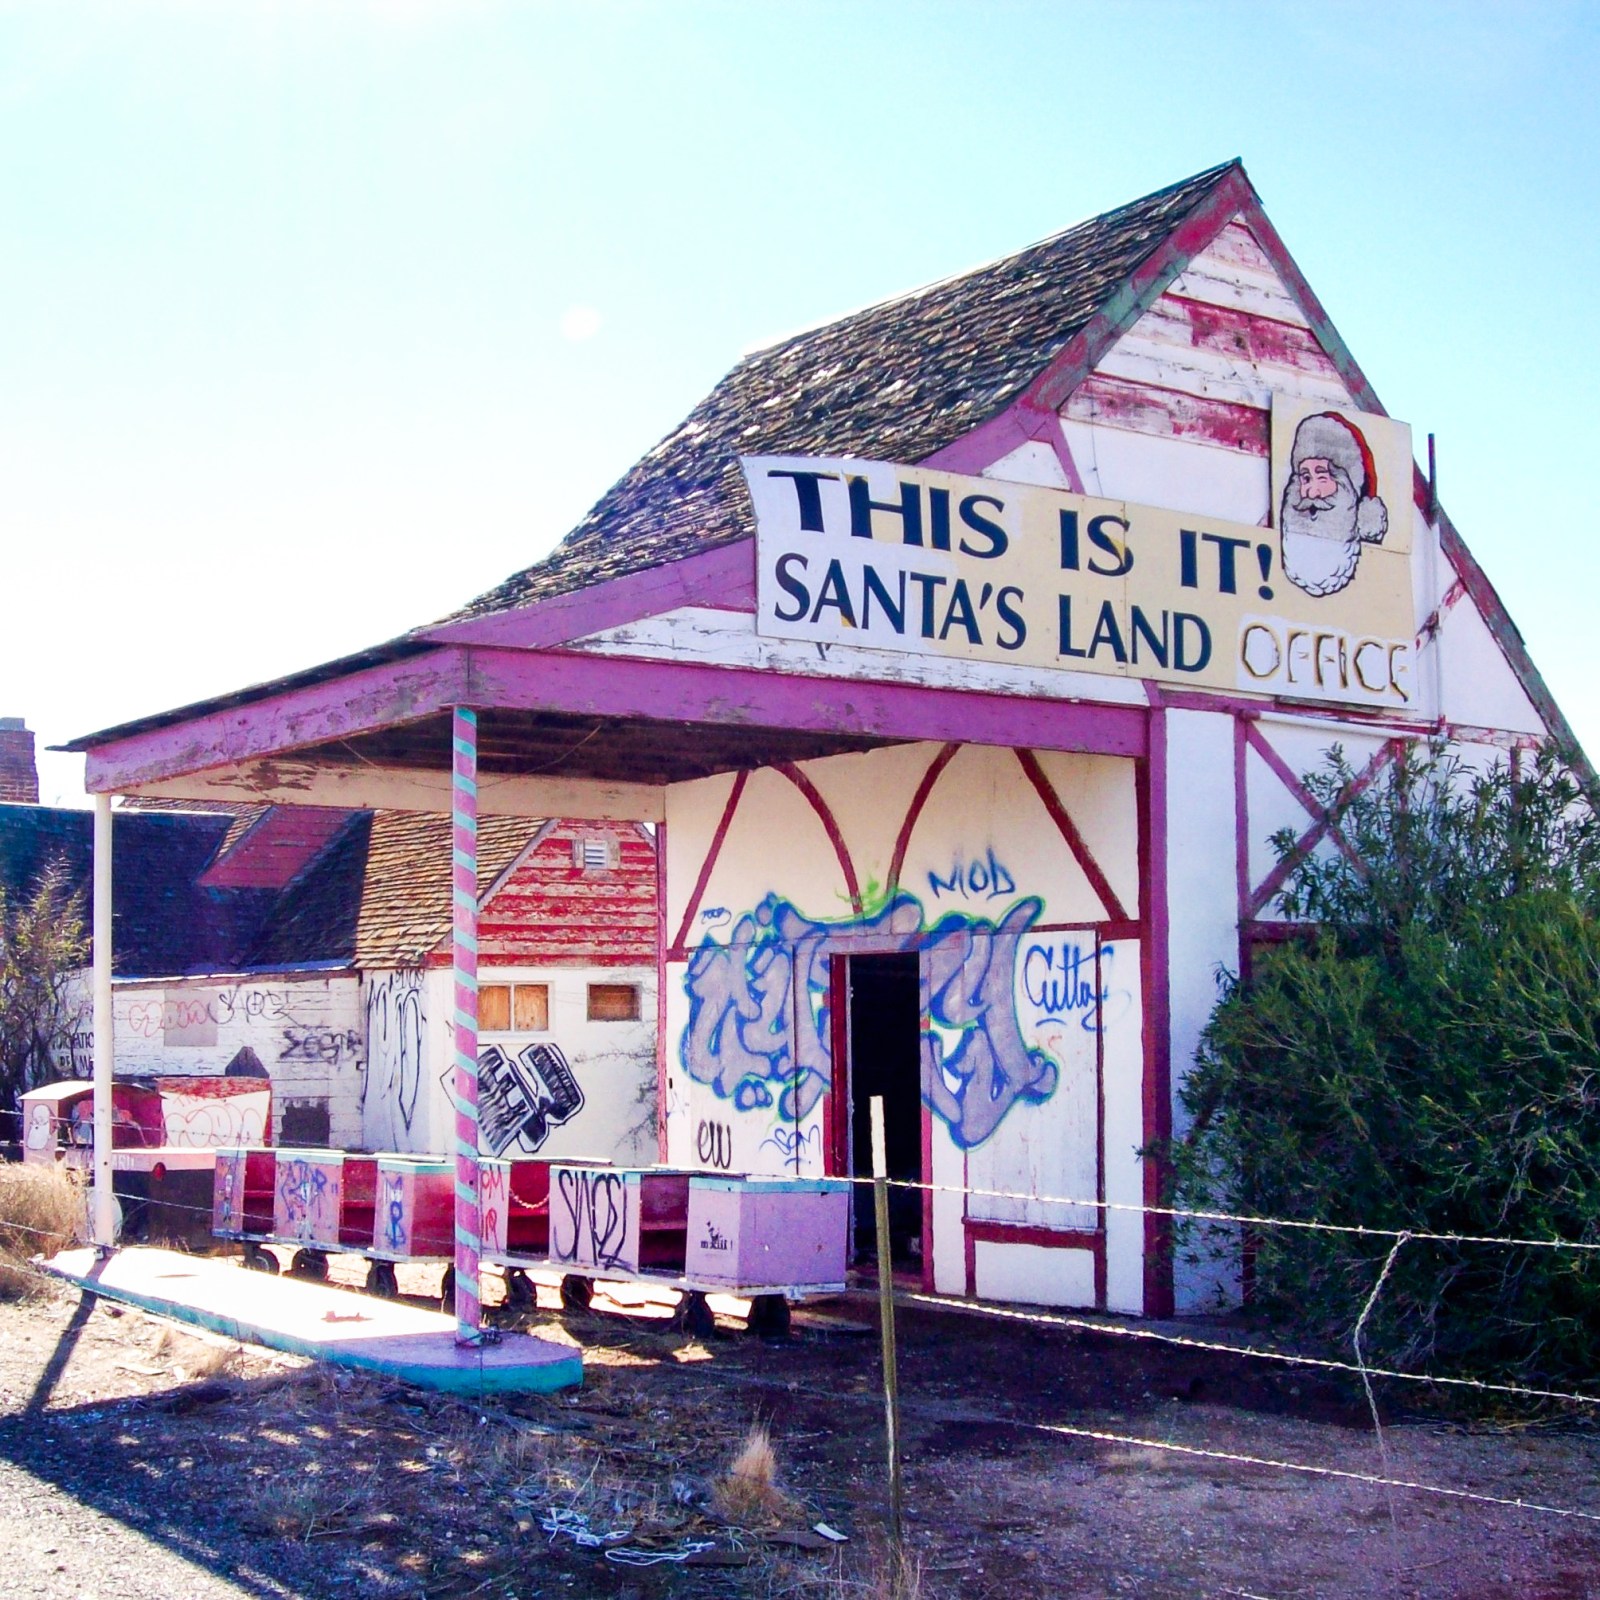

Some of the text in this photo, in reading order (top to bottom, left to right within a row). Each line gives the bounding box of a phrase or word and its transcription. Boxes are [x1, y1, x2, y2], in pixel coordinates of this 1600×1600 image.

[767, 469, 1275, 601] THIS IS IT!
[774, 552, 1409, 703] SANTA'S LAND OFFICE
